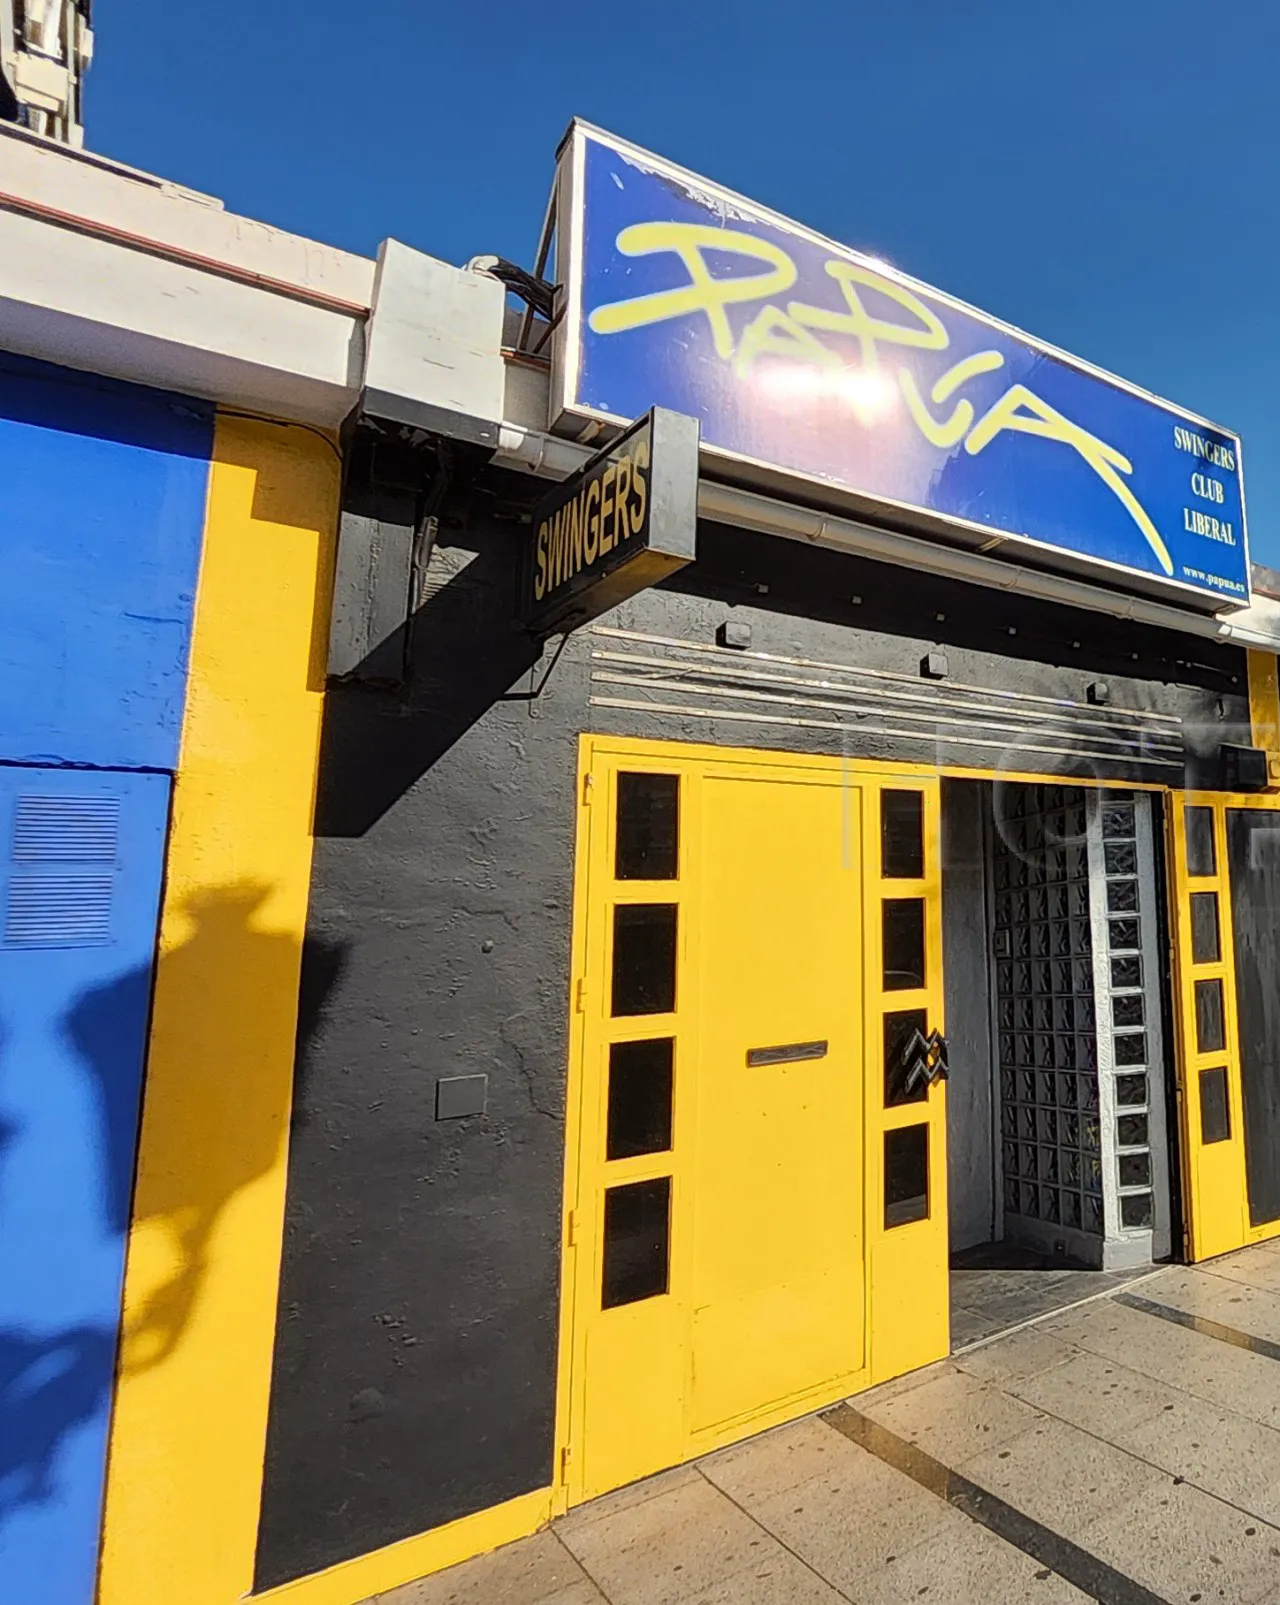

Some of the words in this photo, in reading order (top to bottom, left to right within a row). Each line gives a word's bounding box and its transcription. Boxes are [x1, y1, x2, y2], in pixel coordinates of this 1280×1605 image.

[1173, 425, 1235, 472] SWINGERS
[1191, 472, 1225, 504] CLUB
[534, 441, 650, 600] SWINGERS
[1183, 507, 1236, 546] LIBERAL
[1182, 565, 1245, 593] www.papua.es
